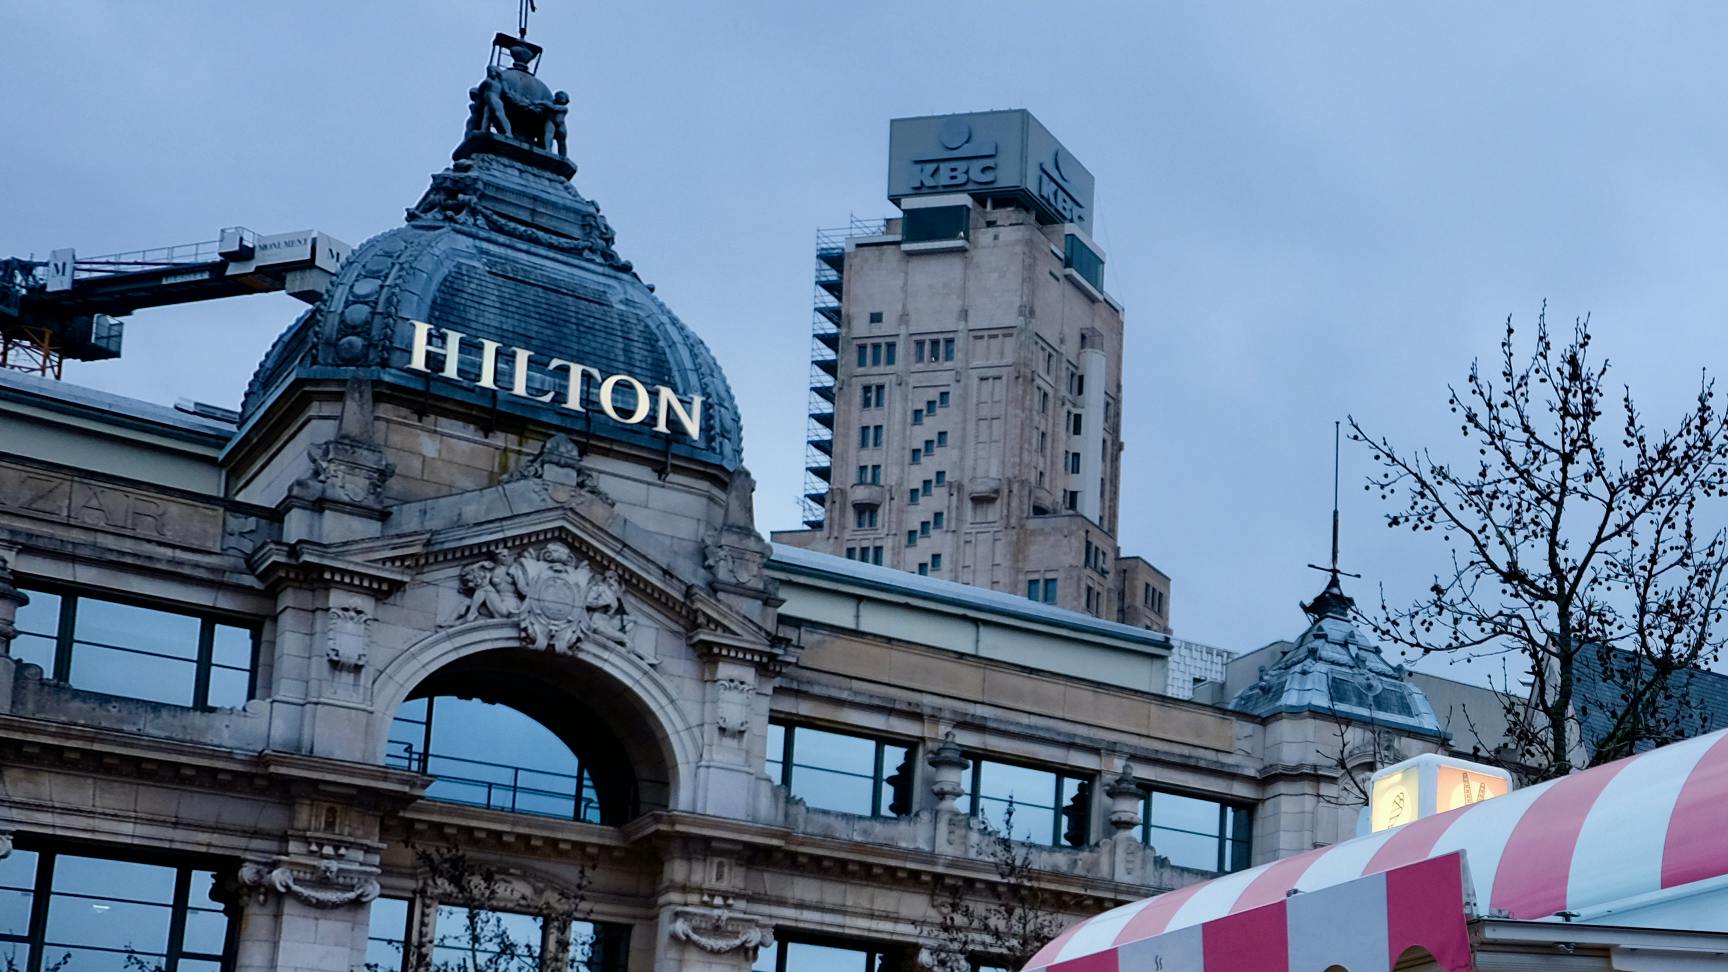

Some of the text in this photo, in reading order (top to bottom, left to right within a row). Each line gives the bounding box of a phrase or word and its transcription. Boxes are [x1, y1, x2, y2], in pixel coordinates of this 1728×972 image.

[911, 162, 998, 190] KBC
[53, 261, 67, 277] M
[404, 319, 706, 441] HILTON
[0, 473, 168, 537] ZAR
